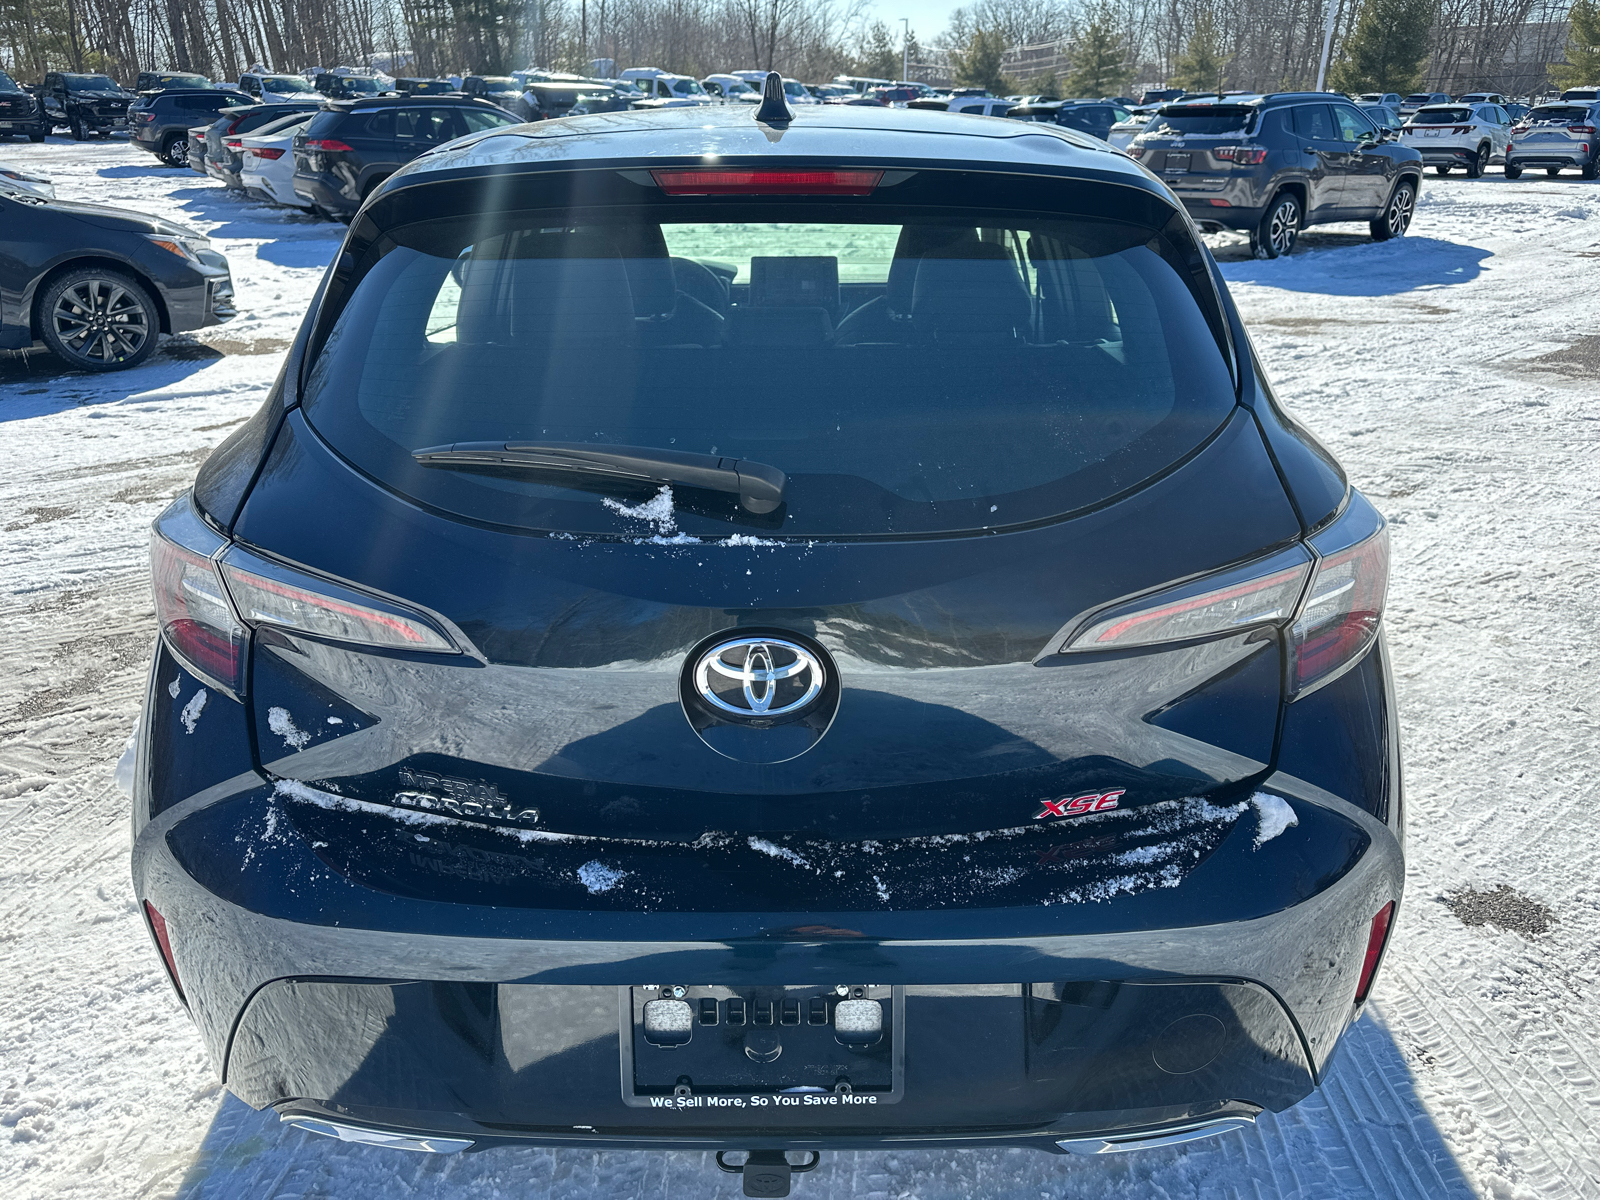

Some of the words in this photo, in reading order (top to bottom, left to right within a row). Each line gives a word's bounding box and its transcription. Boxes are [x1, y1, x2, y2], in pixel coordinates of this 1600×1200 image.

[398, 768, 508, 804] IMPERIAL
[392, 790, 539, 824] COROLLA
[1032, 788, 1127, 820] XSE
[650, 1096, 673, 1108] We
[676, 1096, 702, 1107] Sell
[707, 1096, 747, 1108] More,
[750, 1095, 769, 1107] So
[772, 1095, 800, 1106] You
[803, 1094, 838, 1105] Save
[842, 1094, 877, 1105] More
